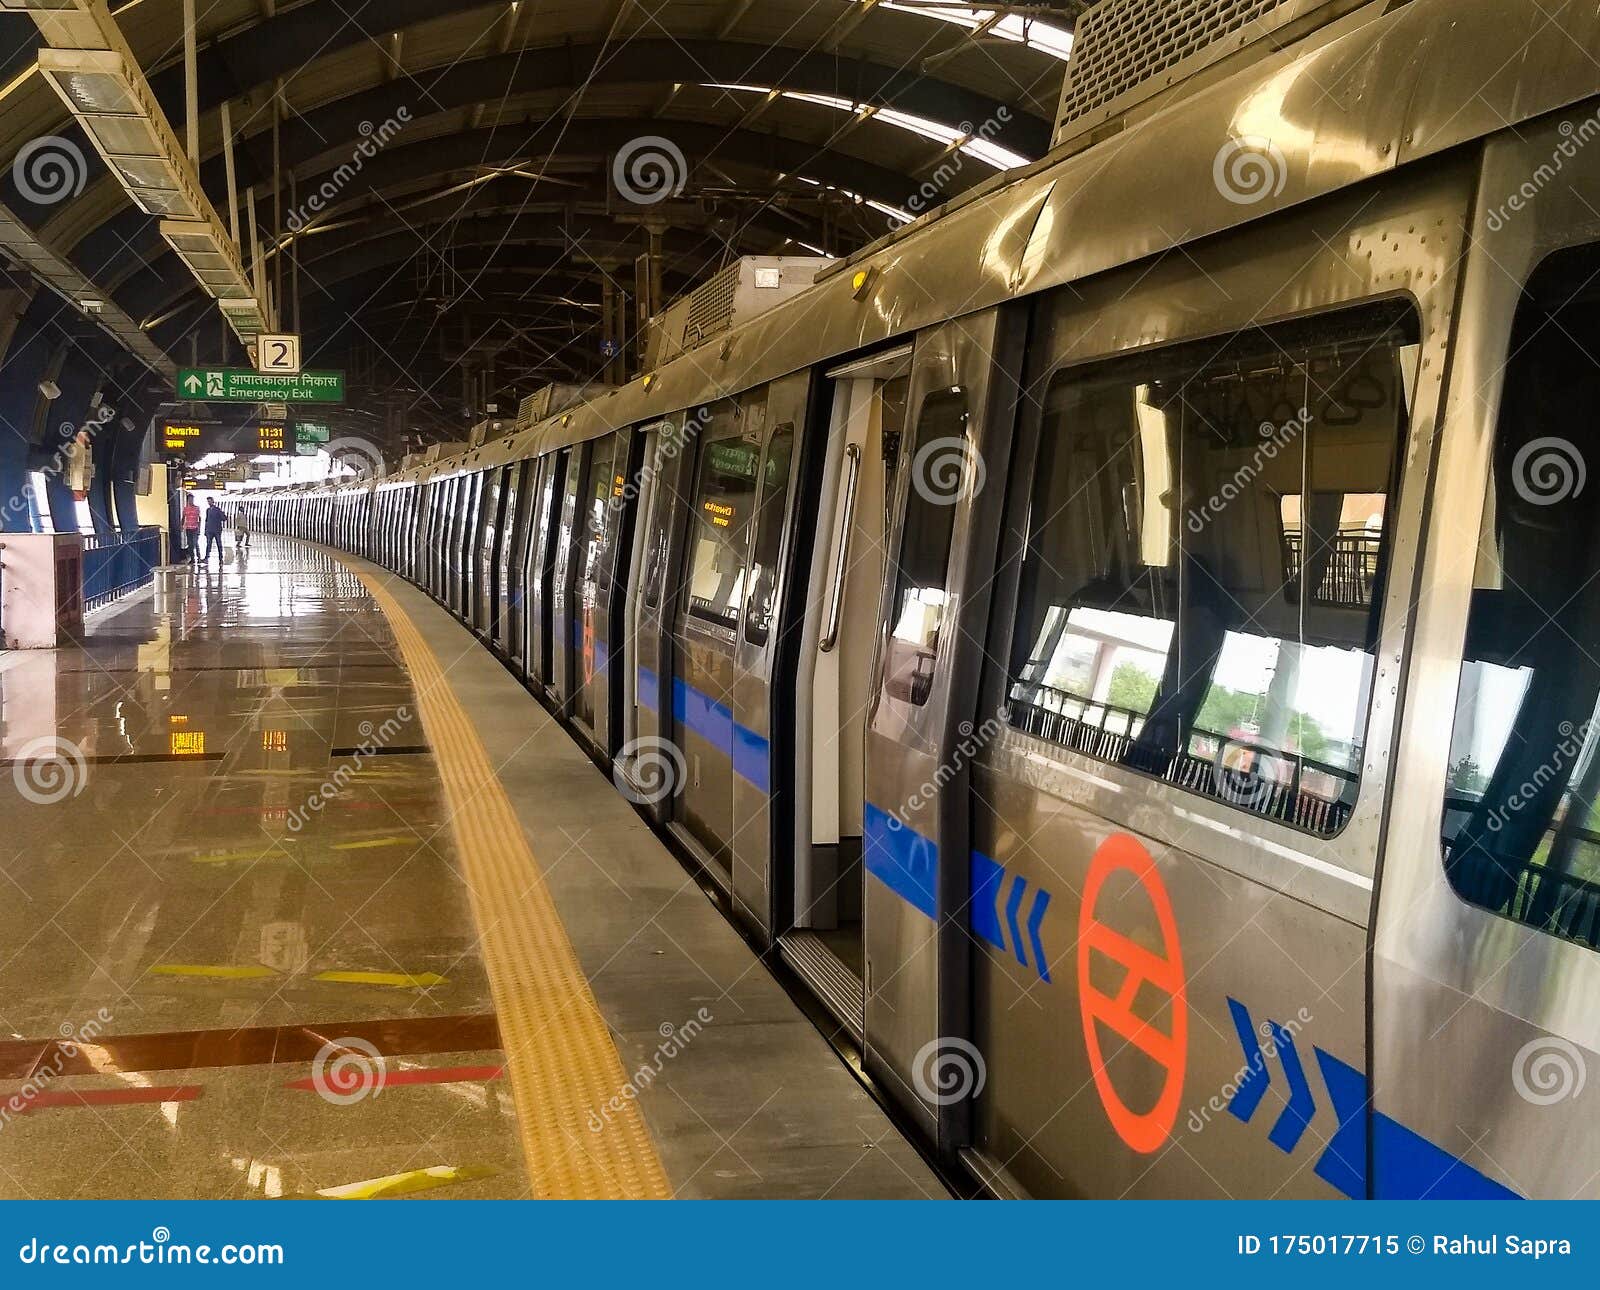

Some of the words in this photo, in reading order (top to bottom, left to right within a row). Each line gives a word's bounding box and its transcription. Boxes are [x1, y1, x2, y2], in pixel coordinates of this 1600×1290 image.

[272, 342, 288, 366] 2
[302, 373, 337, 387] निकास
[229, 388, 289, 400] Emergency
[292, 388, 313, 399] Exit
[166, 426, 200, 436] Dwarka
[259, 427, 283, 437] 11:31
[259, 439, 283, 449] 11:31
